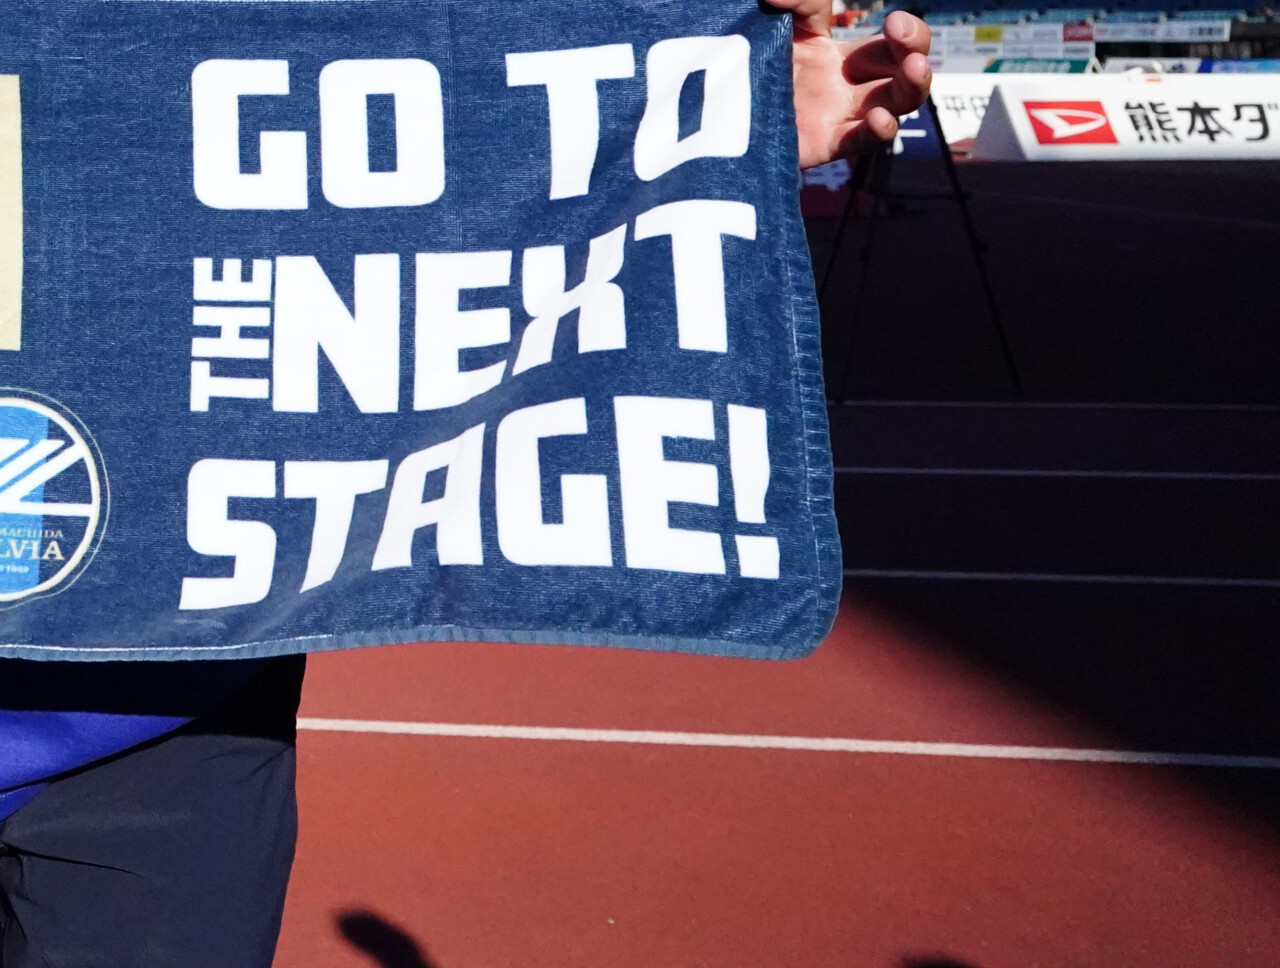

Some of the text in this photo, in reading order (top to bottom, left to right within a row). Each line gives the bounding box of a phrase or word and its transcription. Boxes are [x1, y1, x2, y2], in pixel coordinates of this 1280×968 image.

[191, 34, 751, 211] GO TO
[190, 200, 757, 414] THE NEXT
[178, 396, 780, 611] STAGE!
